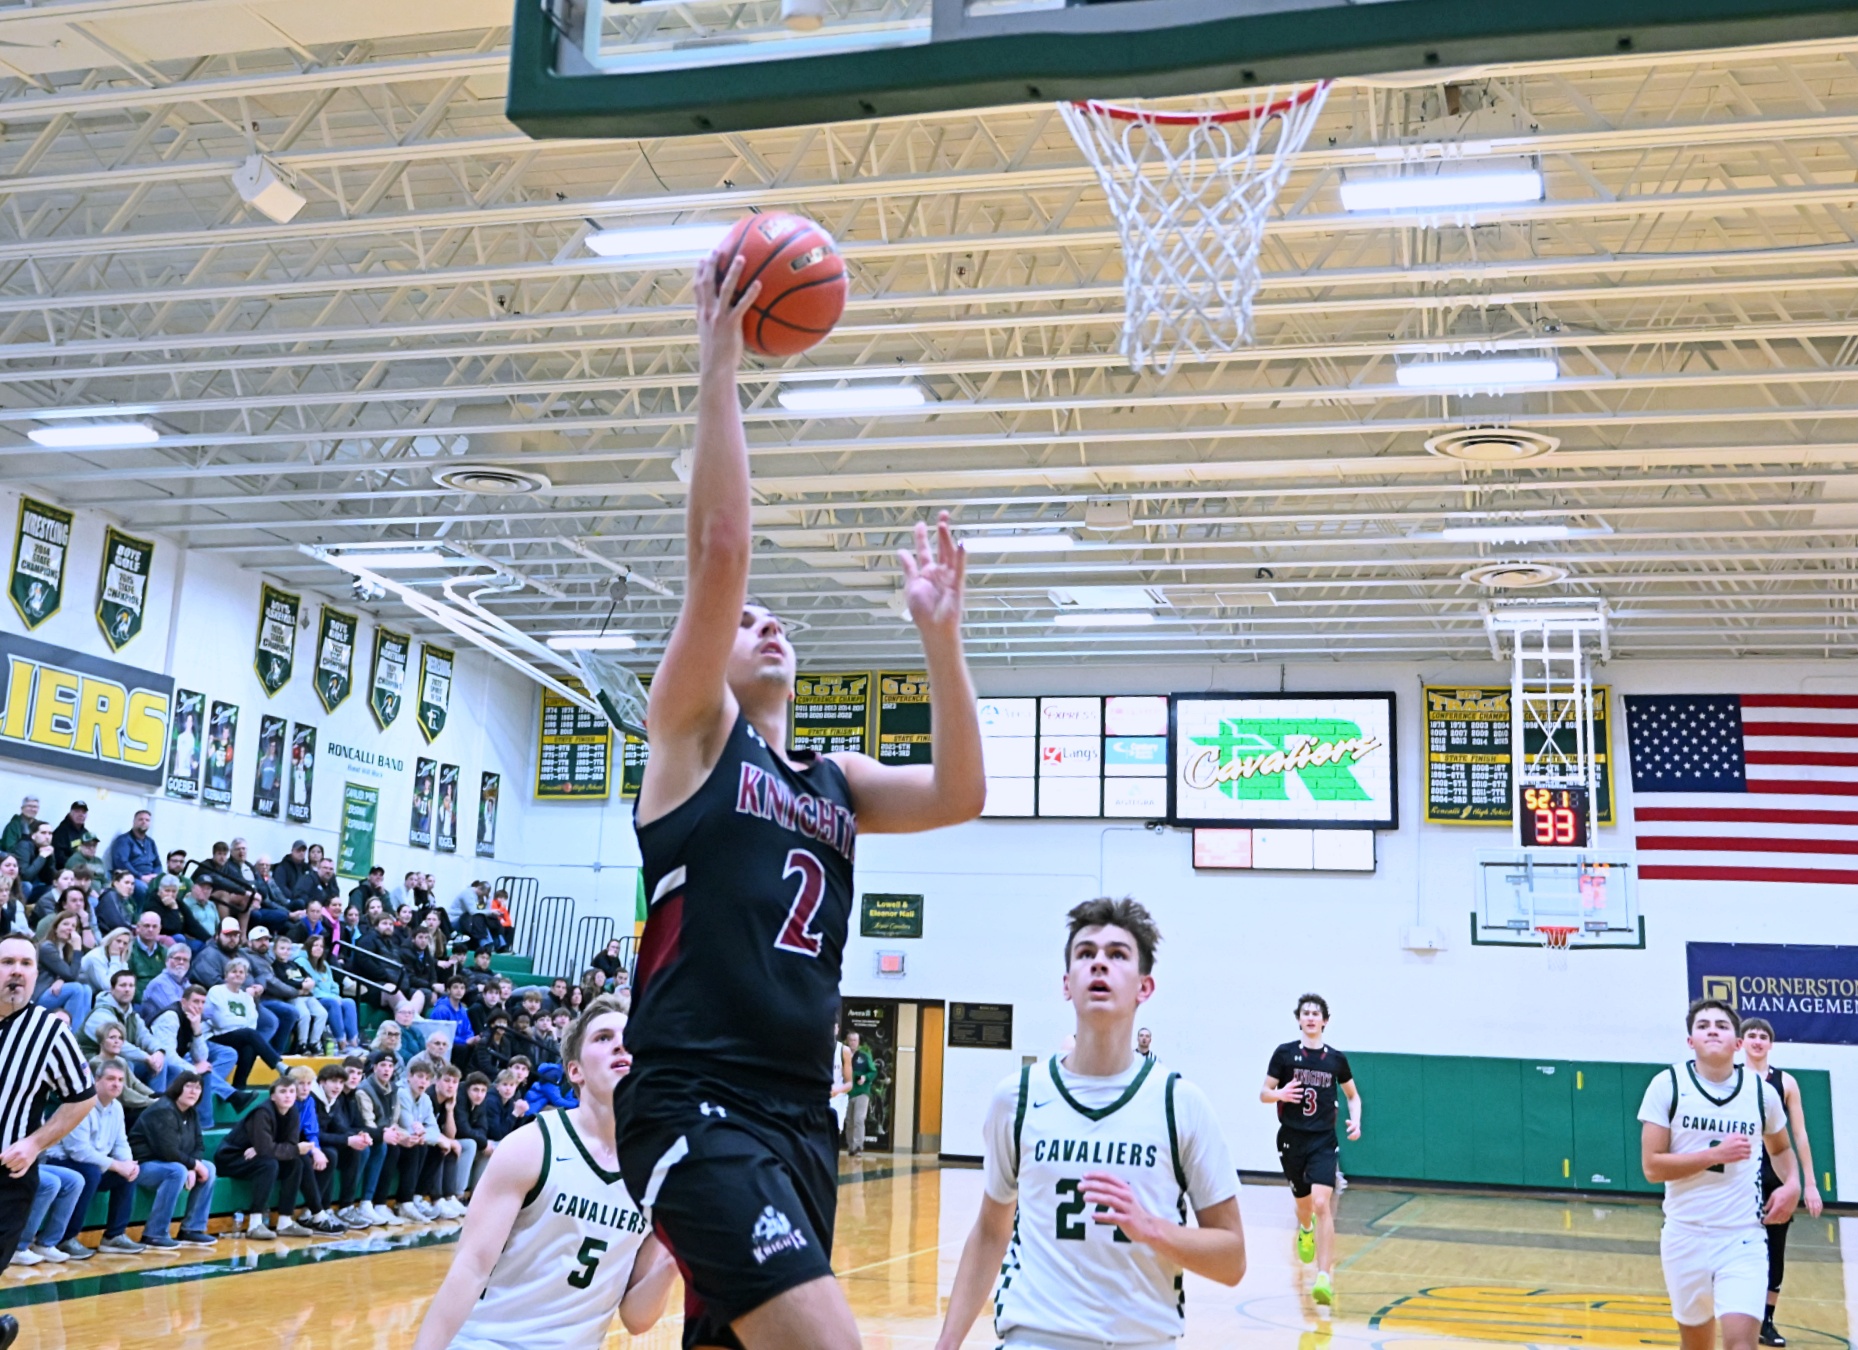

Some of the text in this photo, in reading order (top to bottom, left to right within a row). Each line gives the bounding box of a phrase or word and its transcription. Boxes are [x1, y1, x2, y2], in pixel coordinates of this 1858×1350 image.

[22, 509, 69, 546] WRESTLING
[796, 677, 867, 695] GOLF
[882, 677, 930, 695] GOL
[0, 654, 171, 771] IERS
[1428, 691, 1510, 711] TRACK
[328, 742, 404, 772] RONCALLI BAND
[1063, 747, 1098, 762] Lang's
[1183, 736, 1383, 790] Cavaliers
[167, 776, 198, 795] GOEBEL
[258, 798, 275, 812] MAY
[288, 805, 309, 819] HUBER
[1535, 808, 1576, 844] 33
[774, 848, 826, 957] 2
[1739, 976, 1858, 998] CORNERSTO
[1741, 996, 1858, 1015] MANAGEME
[1293, 1067, 1332, 1088] KNIGHTS
[1302, 1087, 1318, 1116] 3
[1682, 1115, 1756, 1136] CAVALIERS
[1034, 1139, 1158, 1168] CAVALIERS
[552, 1192, 648, 1235] CAVALIERS
[753, 1229, 807, 1265] KNIGHTS
[567, 1236, 608, 1290] 5
